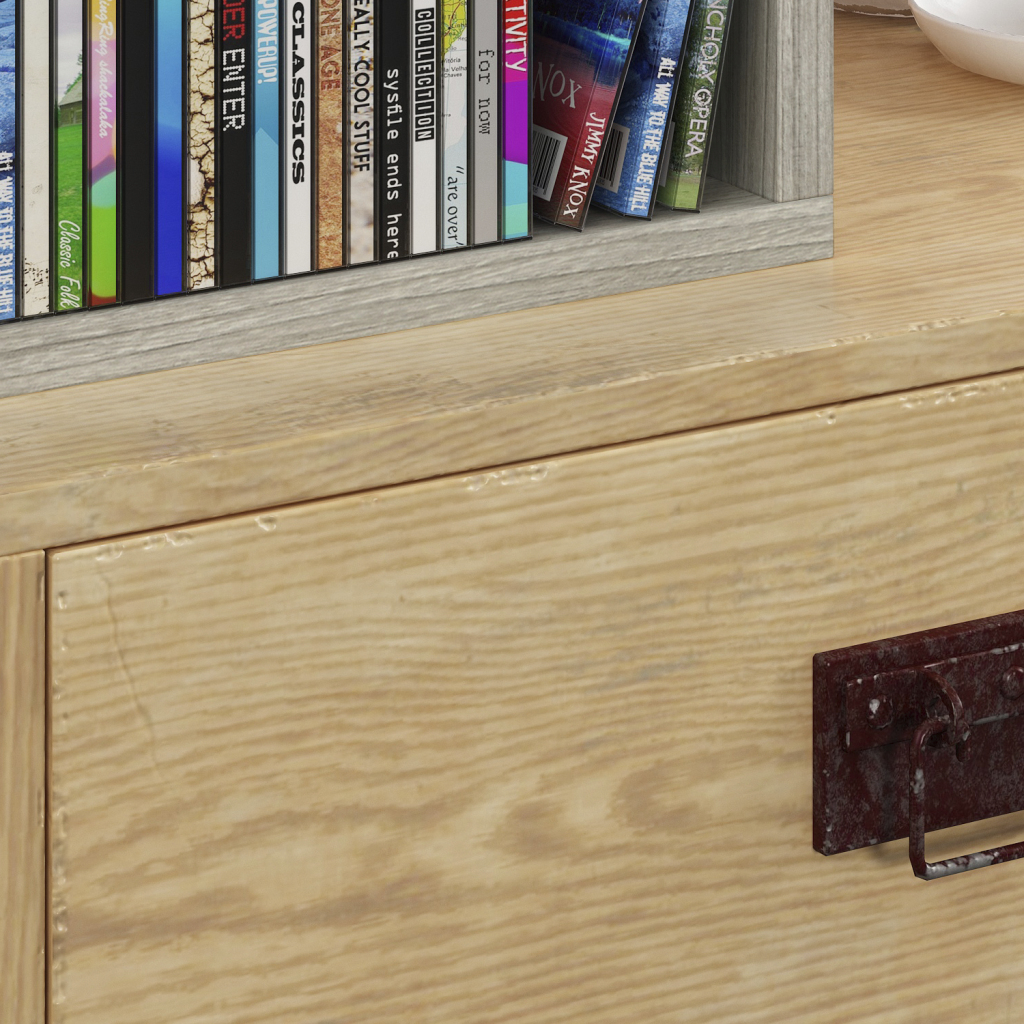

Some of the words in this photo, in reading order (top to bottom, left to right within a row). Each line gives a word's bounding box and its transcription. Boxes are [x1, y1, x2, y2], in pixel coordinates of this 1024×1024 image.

[223, 48, 245, 132] ENTER
[321, 44, 342, 91] AGE
[354, 59, 370, 113] COOL
[416, 9, 433, 140] COLLECTION
[478, 50, 495, 85] for
[657, 57, 676, 78] ALL
[96, 60, 114, 138] shackalaka
[292, 1, 305, 184] CLASSICS
[384, 69, 403, 140] sysfile
[478, 98, 491, 135] now
[651, 81, 672, 108] WAY
[581, 112, 606, 164] JIMMY
[643, 128, 662, 152] THE
[648, 110, 667, 126] TO
[685, 88, 712, 158] OPERA
[354, 121, 370, 172] STUFF
[636, 153, 658, 185] BLUE
[386, 153, 402, 201] ends
[563, 165, 590, 218] KNOX
[631, 186, 651, 212] HILL
[58, 219, 80, 268] Classic
[386, 214, 403, 258] here
[58, 275, 80, 308] Folk
